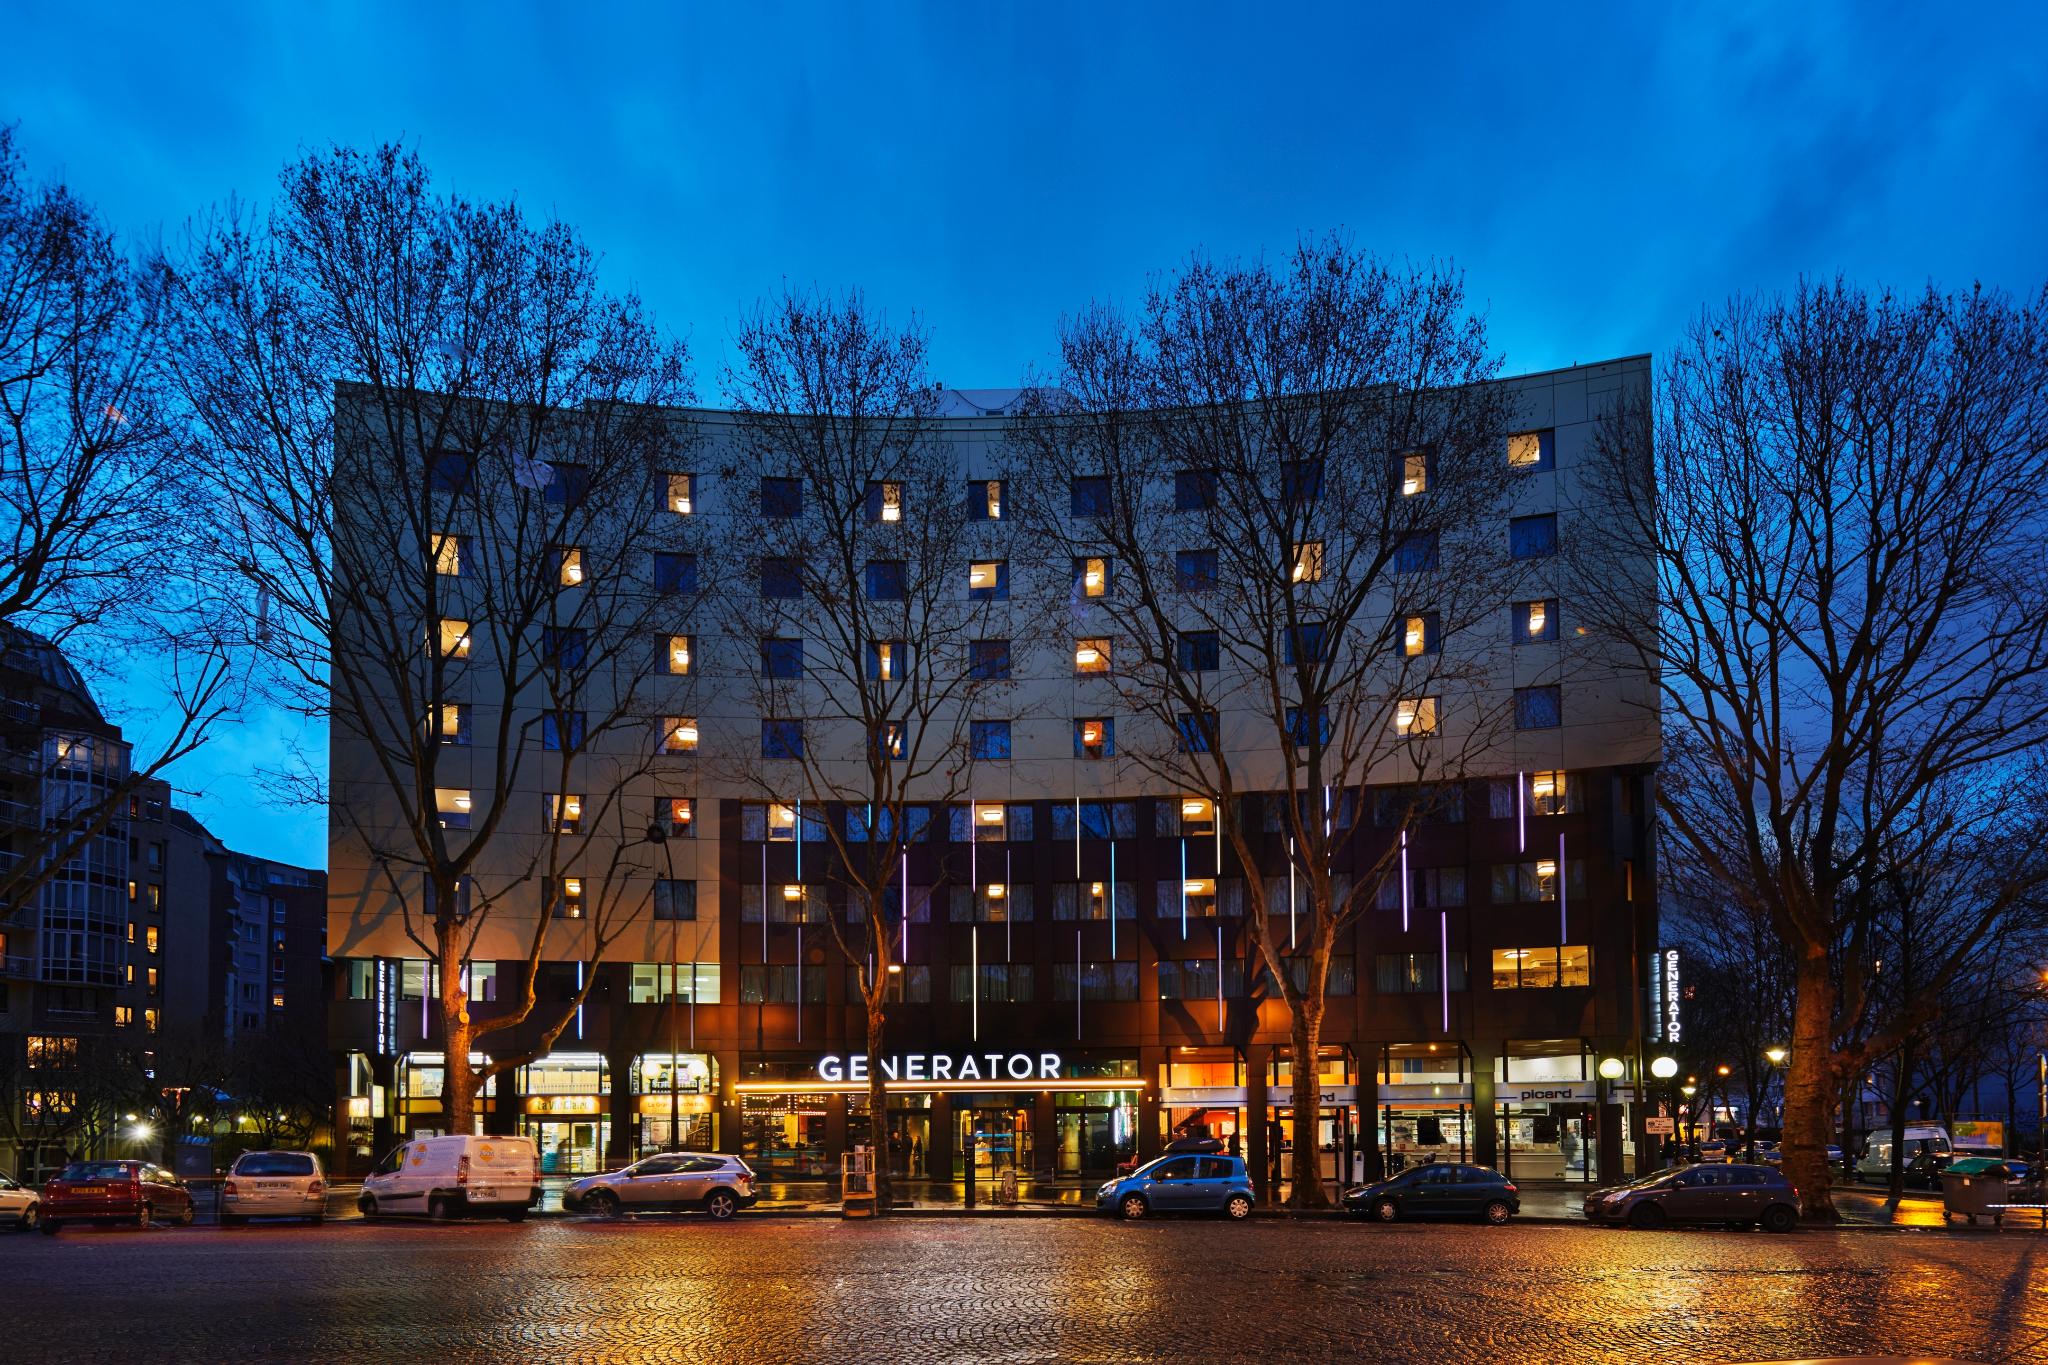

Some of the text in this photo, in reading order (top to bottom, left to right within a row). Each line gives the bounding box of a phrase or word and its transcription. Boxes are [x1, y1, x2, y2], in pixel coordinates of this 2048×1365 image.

[1666, 950, 1681, 1043] GENERATOR
[818, 1053, 1061, 1082] GENERATOR
[1521, 1088, 1572, 1101] picard
